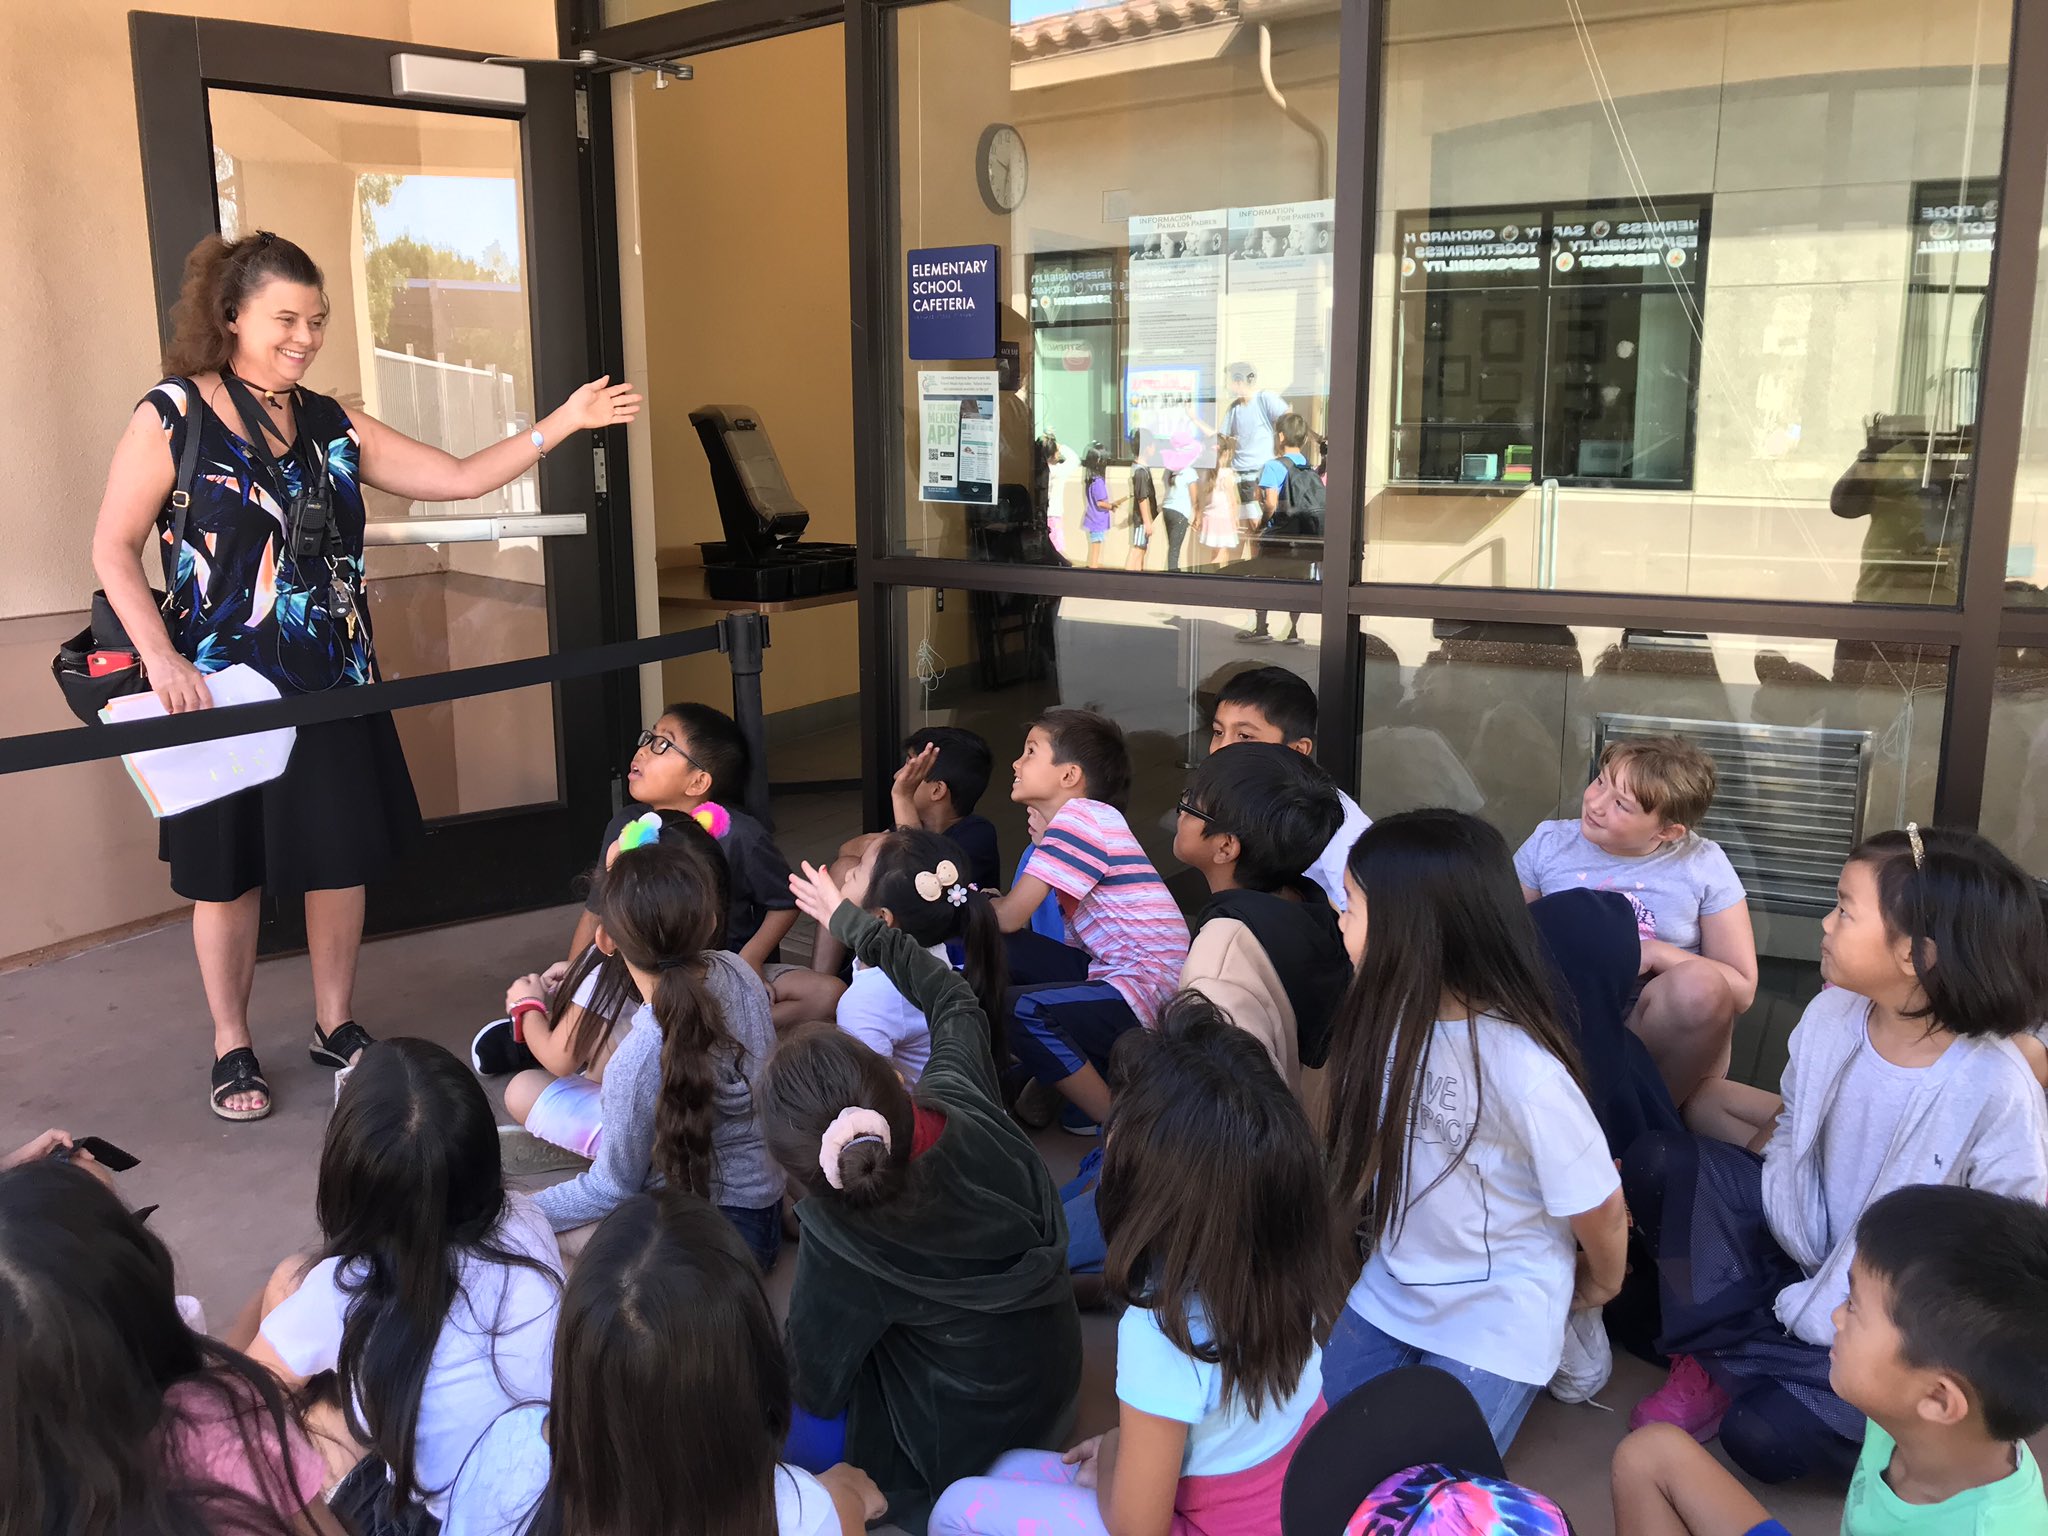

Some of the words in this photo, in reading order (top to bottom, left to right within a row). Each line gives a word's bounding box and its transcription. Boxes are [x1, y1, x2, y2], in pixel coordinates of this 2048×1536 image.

[1239, 207, 1295, 217] INFORMATION
[1292, 212, 1325, 220] PARENTS
[912, 260, 988, 278] ELEMENTARY
[912, 280, 963, 295] SCHOOL
[912, 297, 976, 312] CAFETERIA
[927, 412, 959, 424] MENUS
[927, 425, 956, 445] APP
